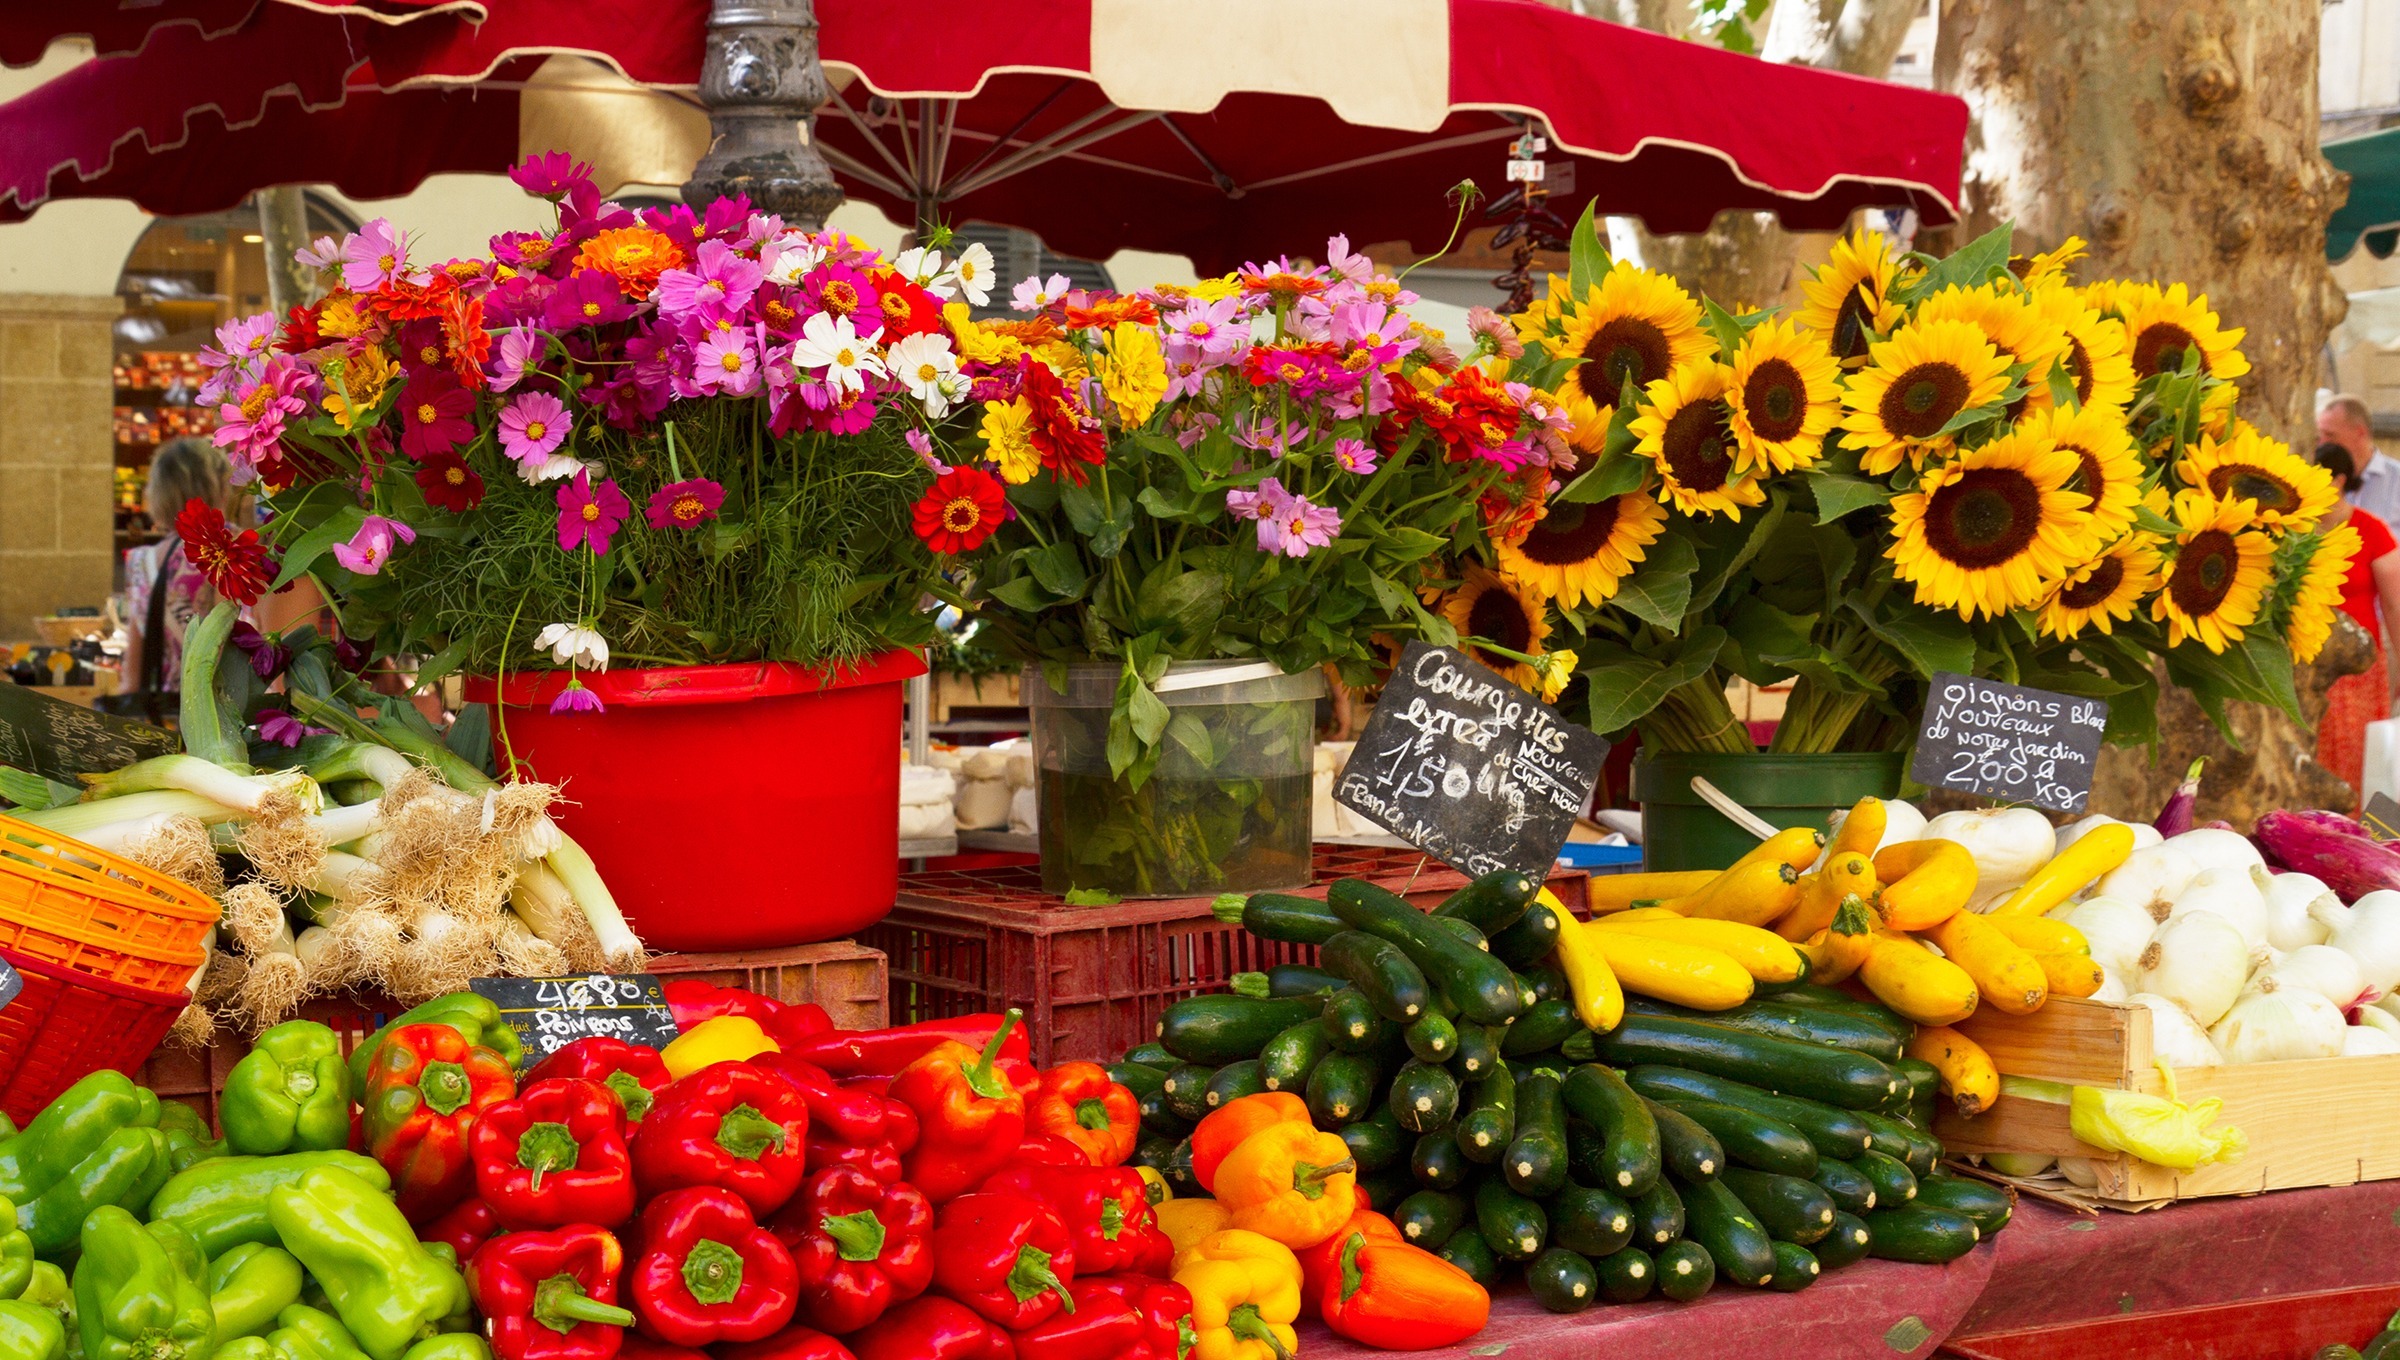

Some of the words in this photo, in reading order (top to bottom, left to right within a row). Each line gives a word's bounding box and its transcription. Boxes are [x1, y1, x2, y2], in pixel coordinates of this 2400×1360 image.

[1413, 649, 1569, 753] Courgettes
[1494, 750, 1511, 768] de
[1926, 719, 1950, 739] de
[2010, 731, 2085, 765] jardin
